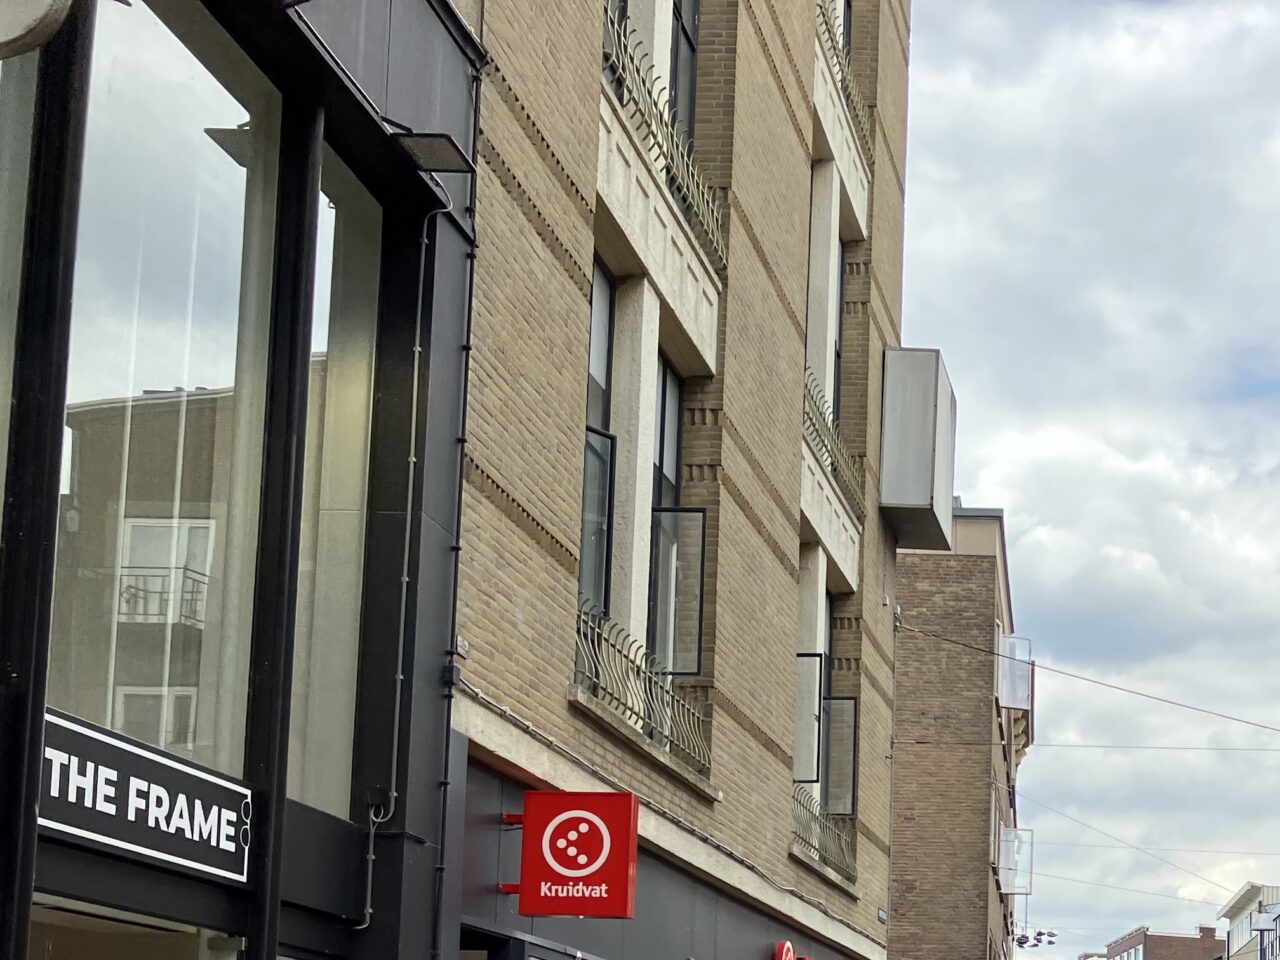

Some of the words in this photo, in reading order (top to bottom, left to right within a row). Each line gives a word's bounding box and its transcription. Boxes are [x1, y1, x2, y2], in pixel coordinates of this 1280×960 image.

[45, 746, 118, 816] THE
[127, 776, 238, 853] FRAME
[540, 881, 609, 898] Kruidvat
